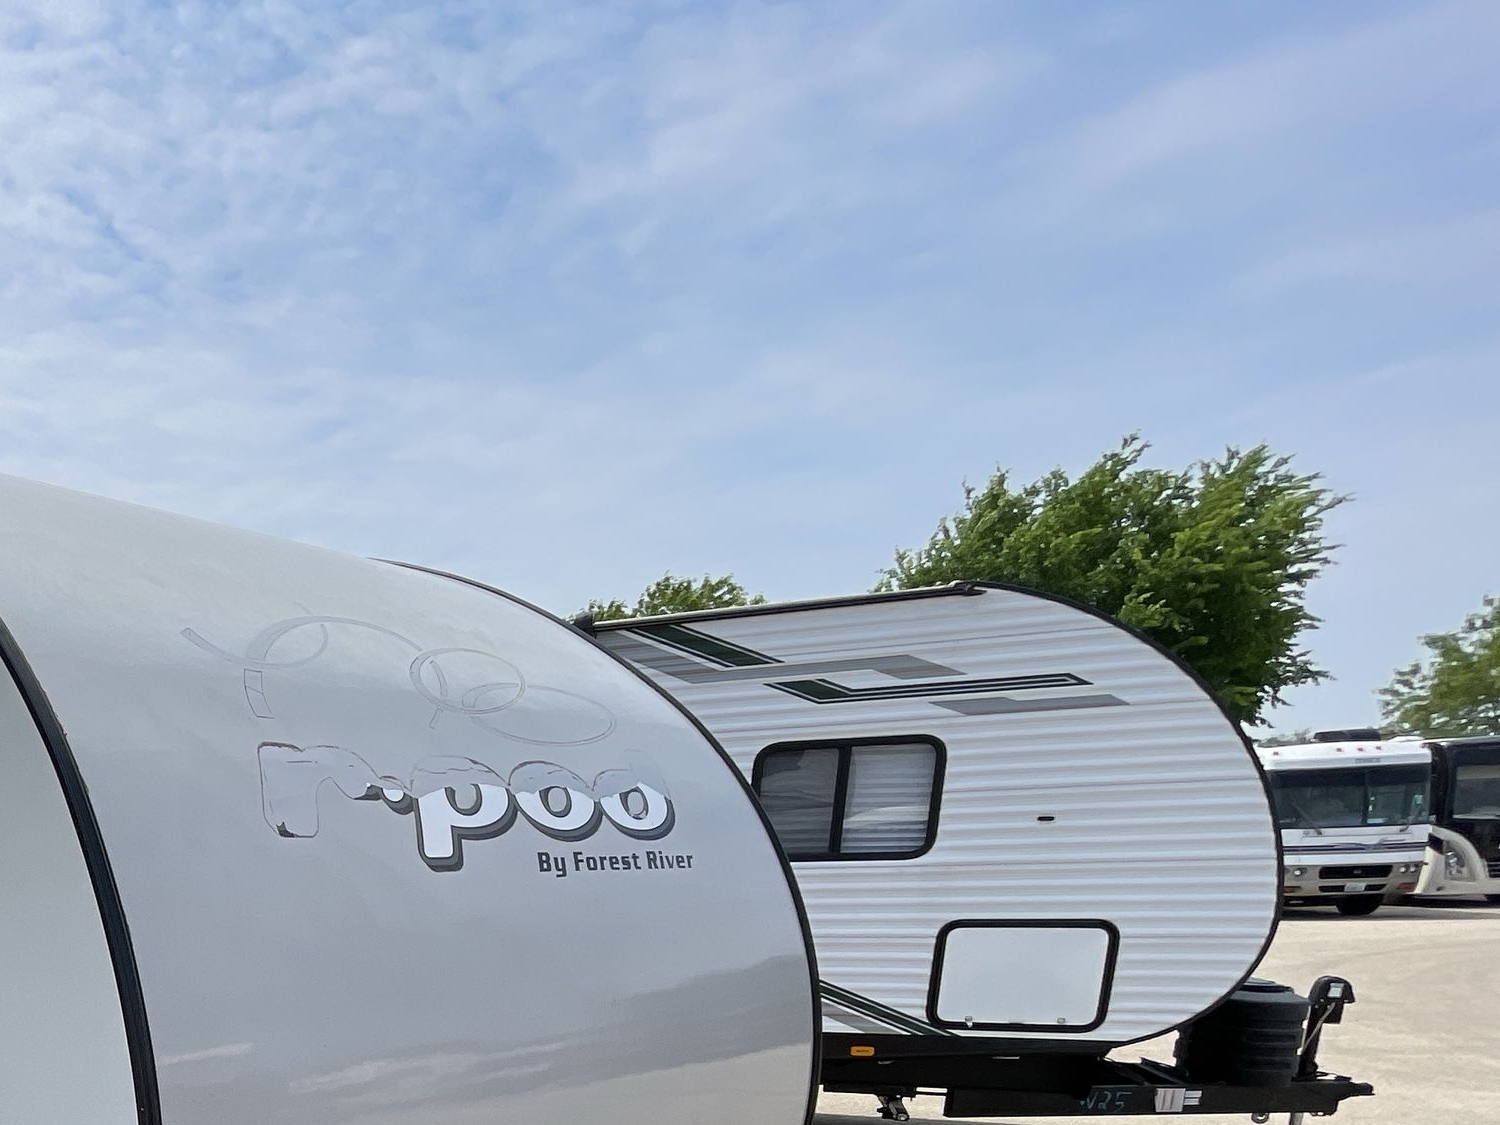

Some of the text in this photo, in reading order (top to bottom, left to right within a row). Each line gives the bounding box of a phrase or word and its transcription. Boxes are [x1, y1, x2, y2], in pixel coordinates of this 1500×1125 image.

[537, 850, 693, 878] By Forest River
